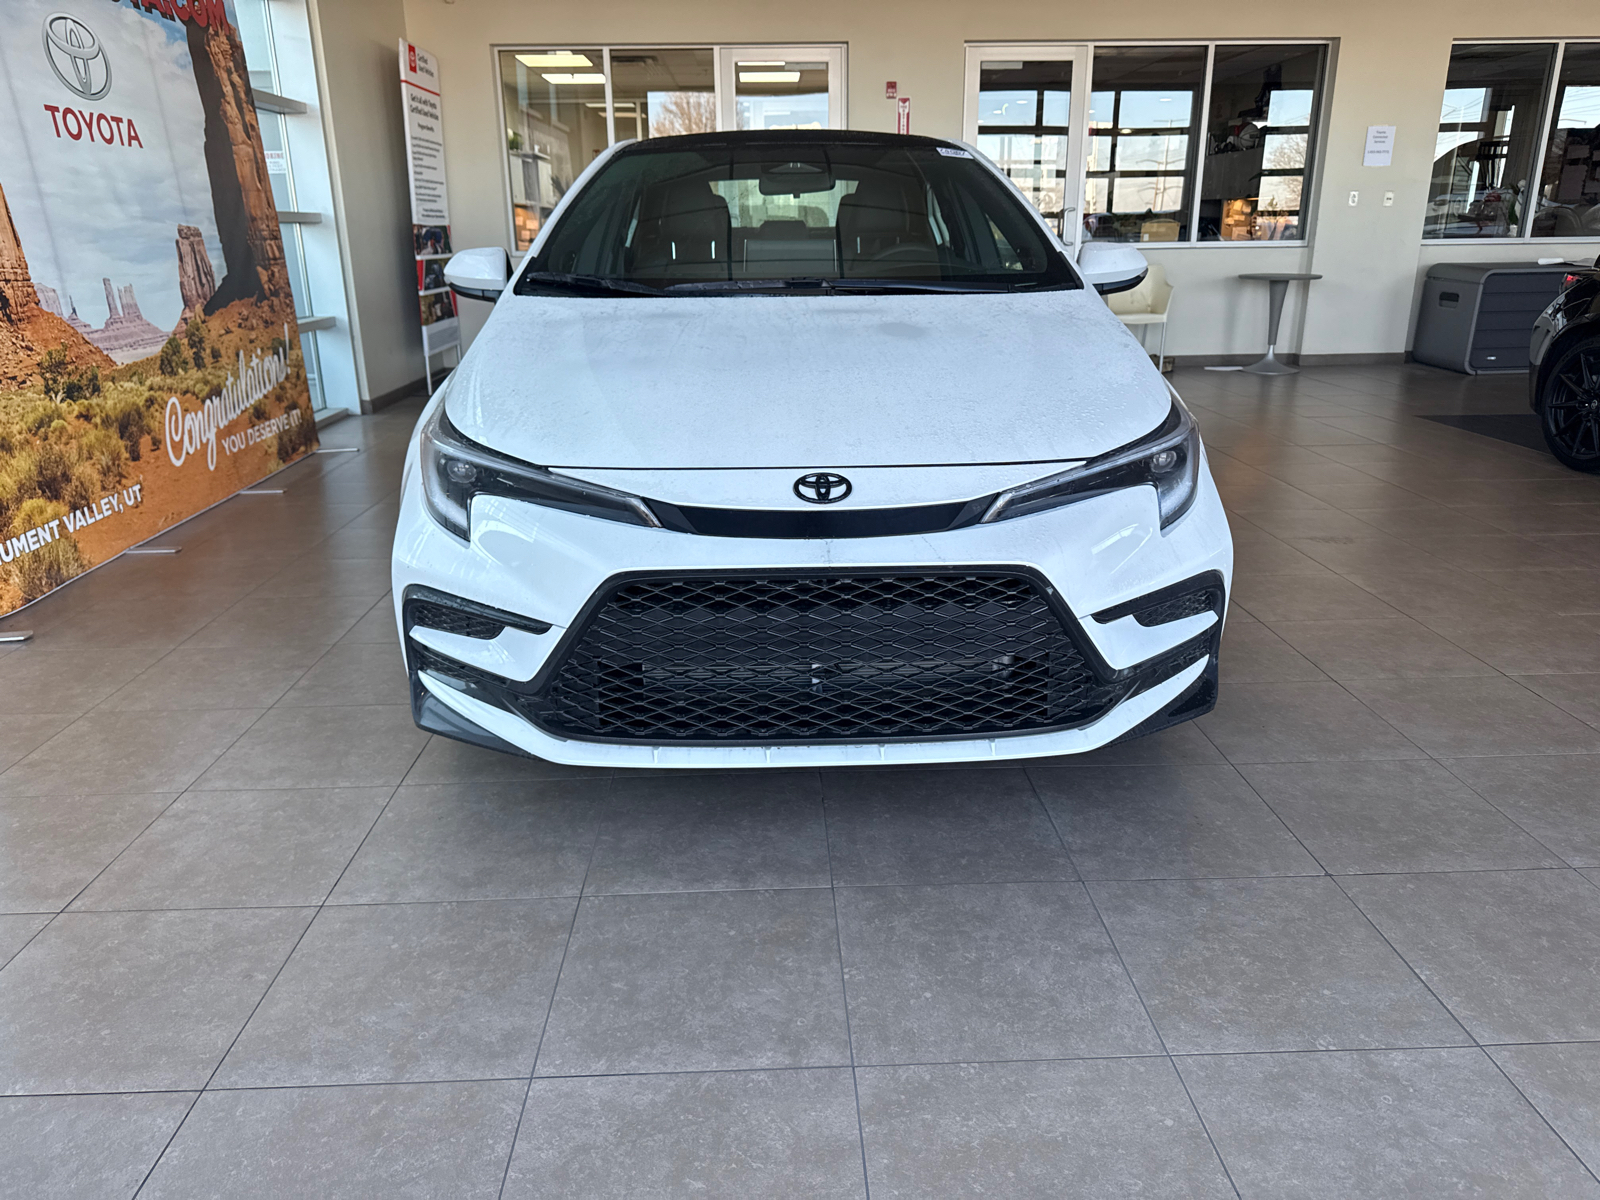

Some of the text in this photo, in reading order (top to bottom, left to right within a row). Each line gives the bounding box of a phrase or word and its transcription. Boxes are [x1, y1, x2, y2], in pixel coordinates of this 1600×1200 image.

[43, 104, 143, 149] TOYOTA
[165, 322, 291, 471] Congratulations!
[221, 408, 302, 456] YOU DESERVE IT!
[0, 484, 142, 566] UMENT VALLEY, UT
